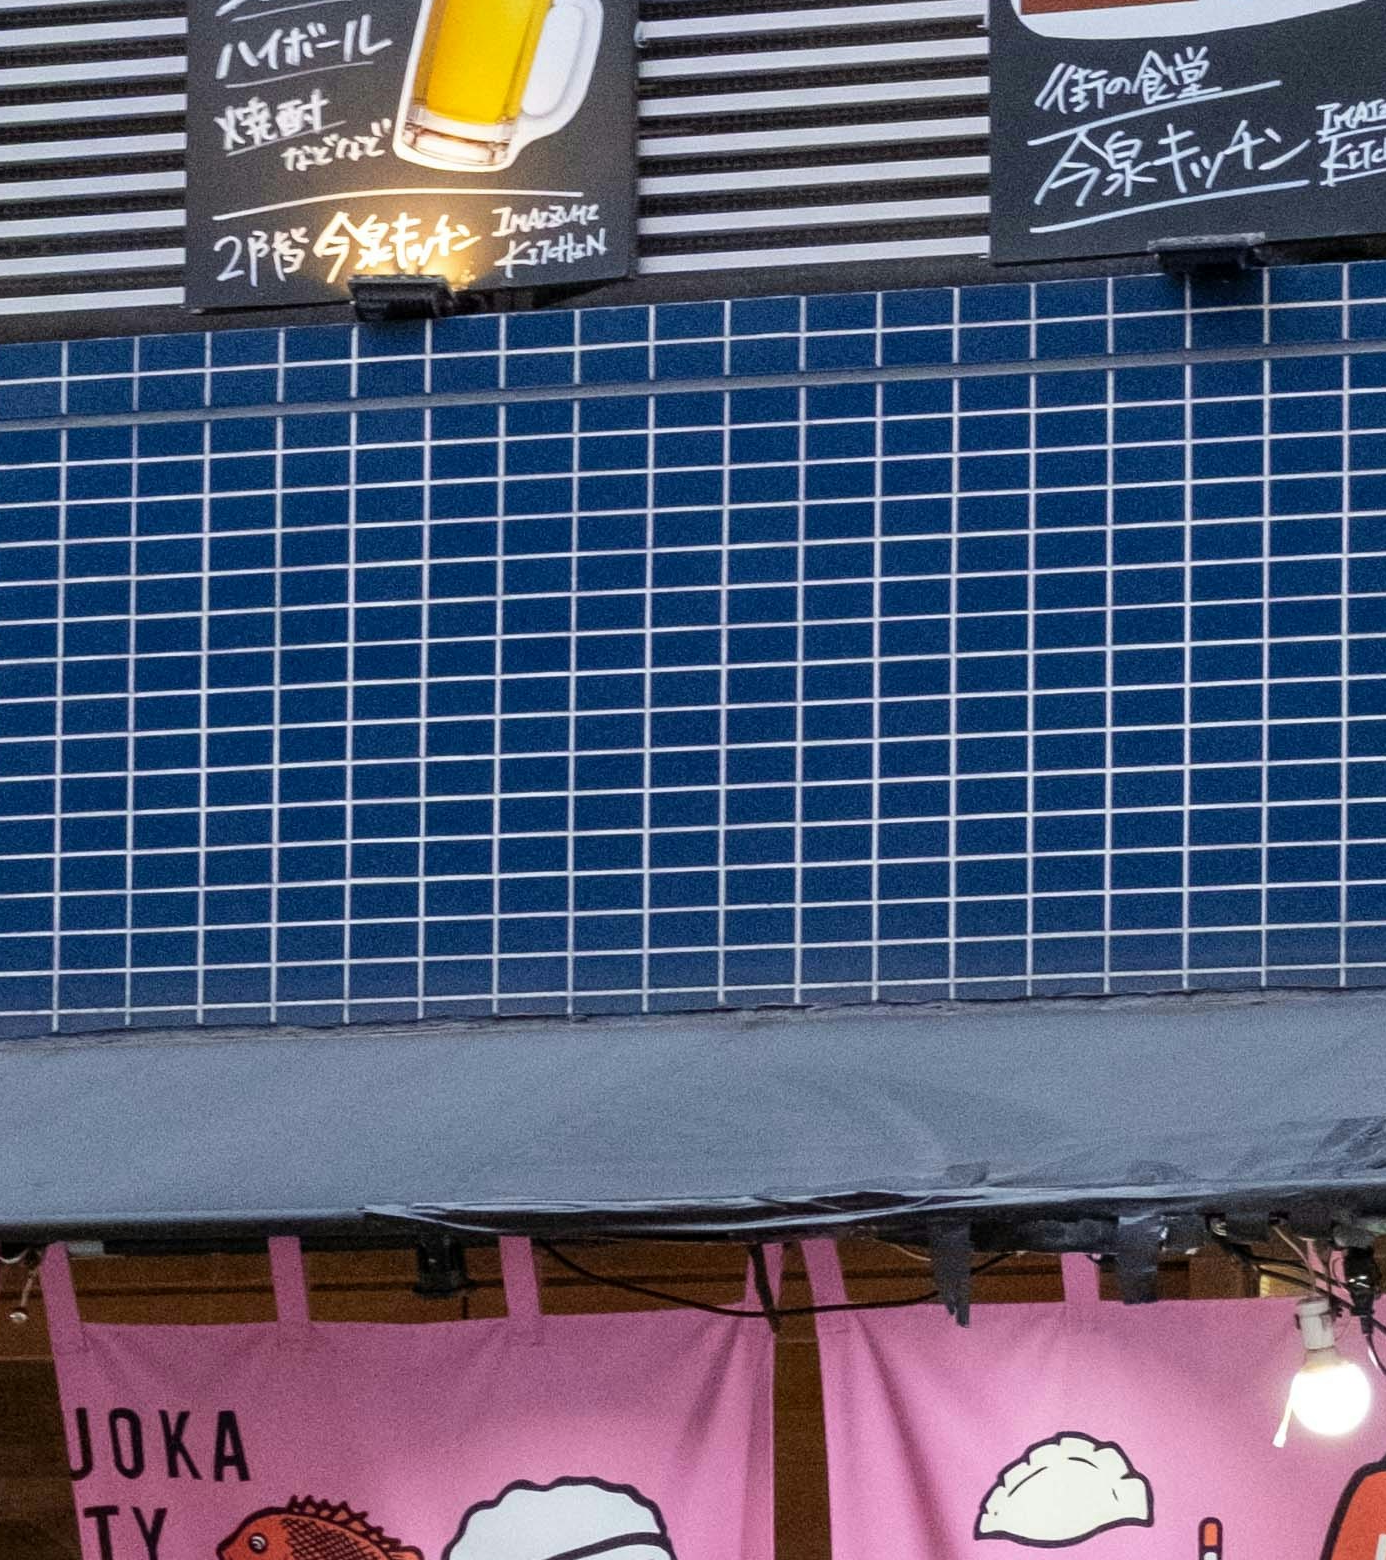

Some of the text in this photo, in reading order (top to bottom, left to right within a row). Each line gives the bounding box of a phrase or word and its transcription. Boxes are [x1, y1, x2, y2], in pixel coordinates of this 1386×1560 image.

[216, 14, 392, 78] ハイボール
[1035, 45, 1216, 116] 街の食堂
[216, 89, 329, 148] 焼酎
[283, 119, 393, 172] などなど
[1034, 119, 1312, 208] 今泉キッチン
[213, 211, 482, 287] 2階 今泉キッチン
